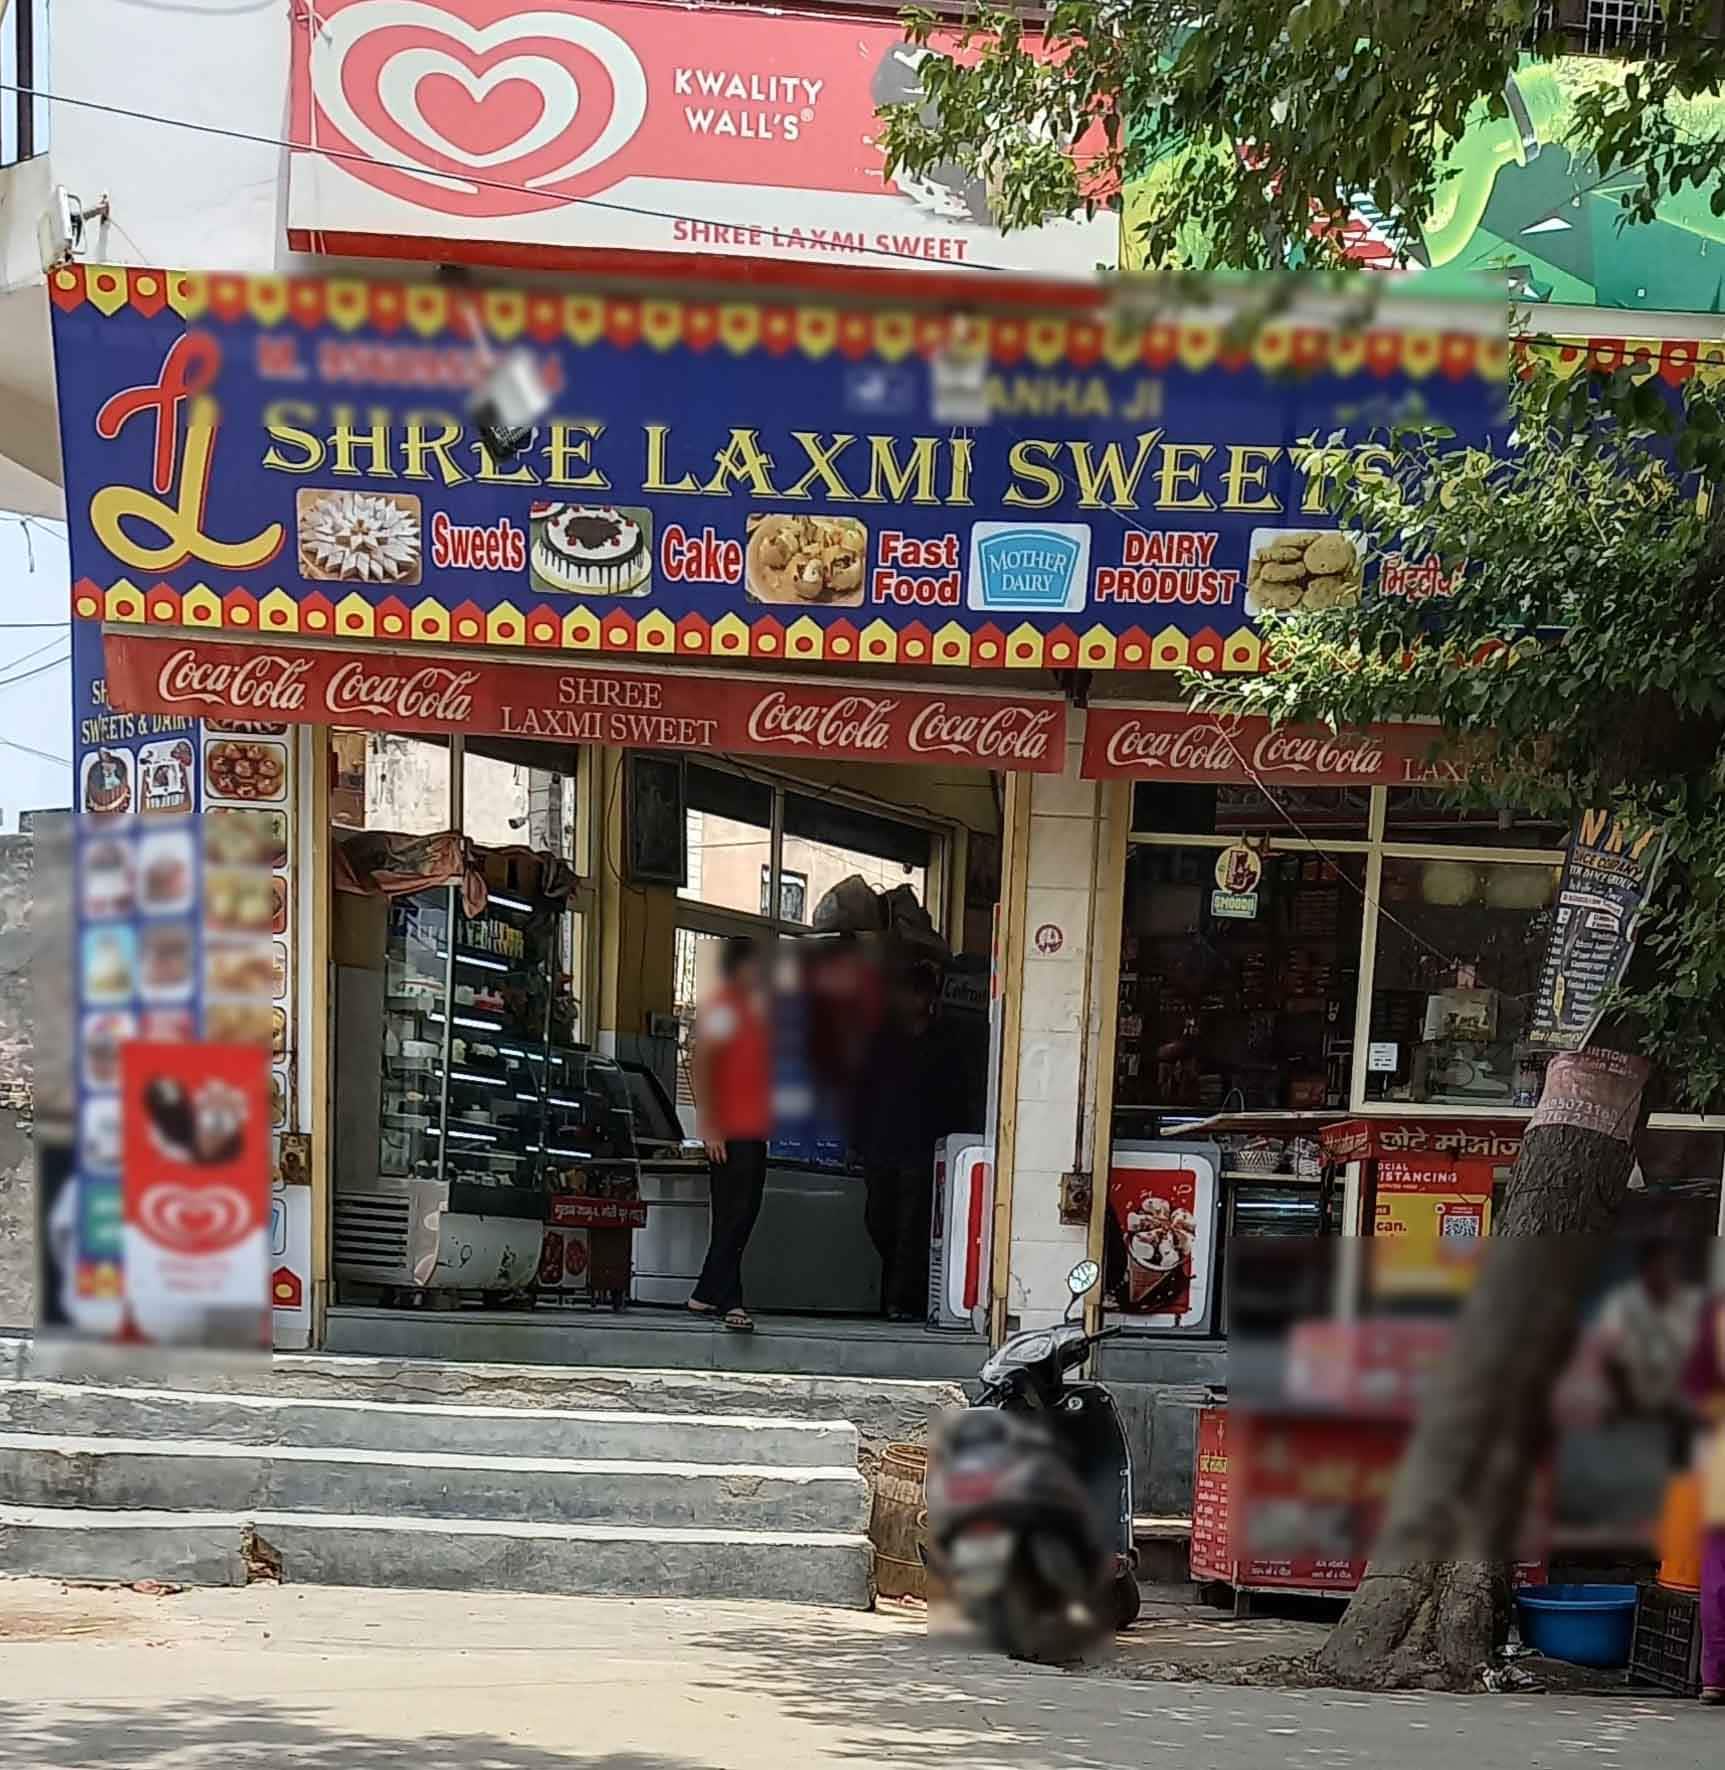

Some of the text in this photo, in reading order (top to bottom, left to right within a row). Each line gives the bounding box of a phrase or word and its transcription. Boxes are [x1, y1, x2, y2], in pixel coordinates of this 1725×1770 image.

[673, 68, 823, 105] KWALITY
[684, 107, 801, 141] WALL'S
[672, 219, 968, 261] SHREE LAXMI SWEET
[981, 374, 1111, 418] ANHA
[641, 425, 976, 507] LAXMI
[432, 512, 525, 572] Sweets
[661, 523, 743, 585] Cake
[879, 530, 960, 569] Fast
[1122, 530, 1219, 567] DAIRY
[988, 549, 1067, 575] MOTHER
[872, 569, 961, 605] Food
[1001, 571, 1054, 594] DAIRY
[1095, 567, 1239, 605] PRODUST
[159, 649, 314, 710] Coca-Cola
[326, 661, 480, 722] Coca-Cola
[558, 676, 664, 709] SHREE
[81, 714, 135, 745] SWEETS
[137, 714, 149, 735] &
[500, 705, 719, 746] LAXMI SWEET
[748, 691, 1056, 760] Coca-Cola Coca-Cola
[1106, 720, 1384, 775] Coca-Cola Coca-Cola
[1377, 1163, 1409, 1172] OCIAL
[1378, 1171, 1458, 1184] ISTANCING
